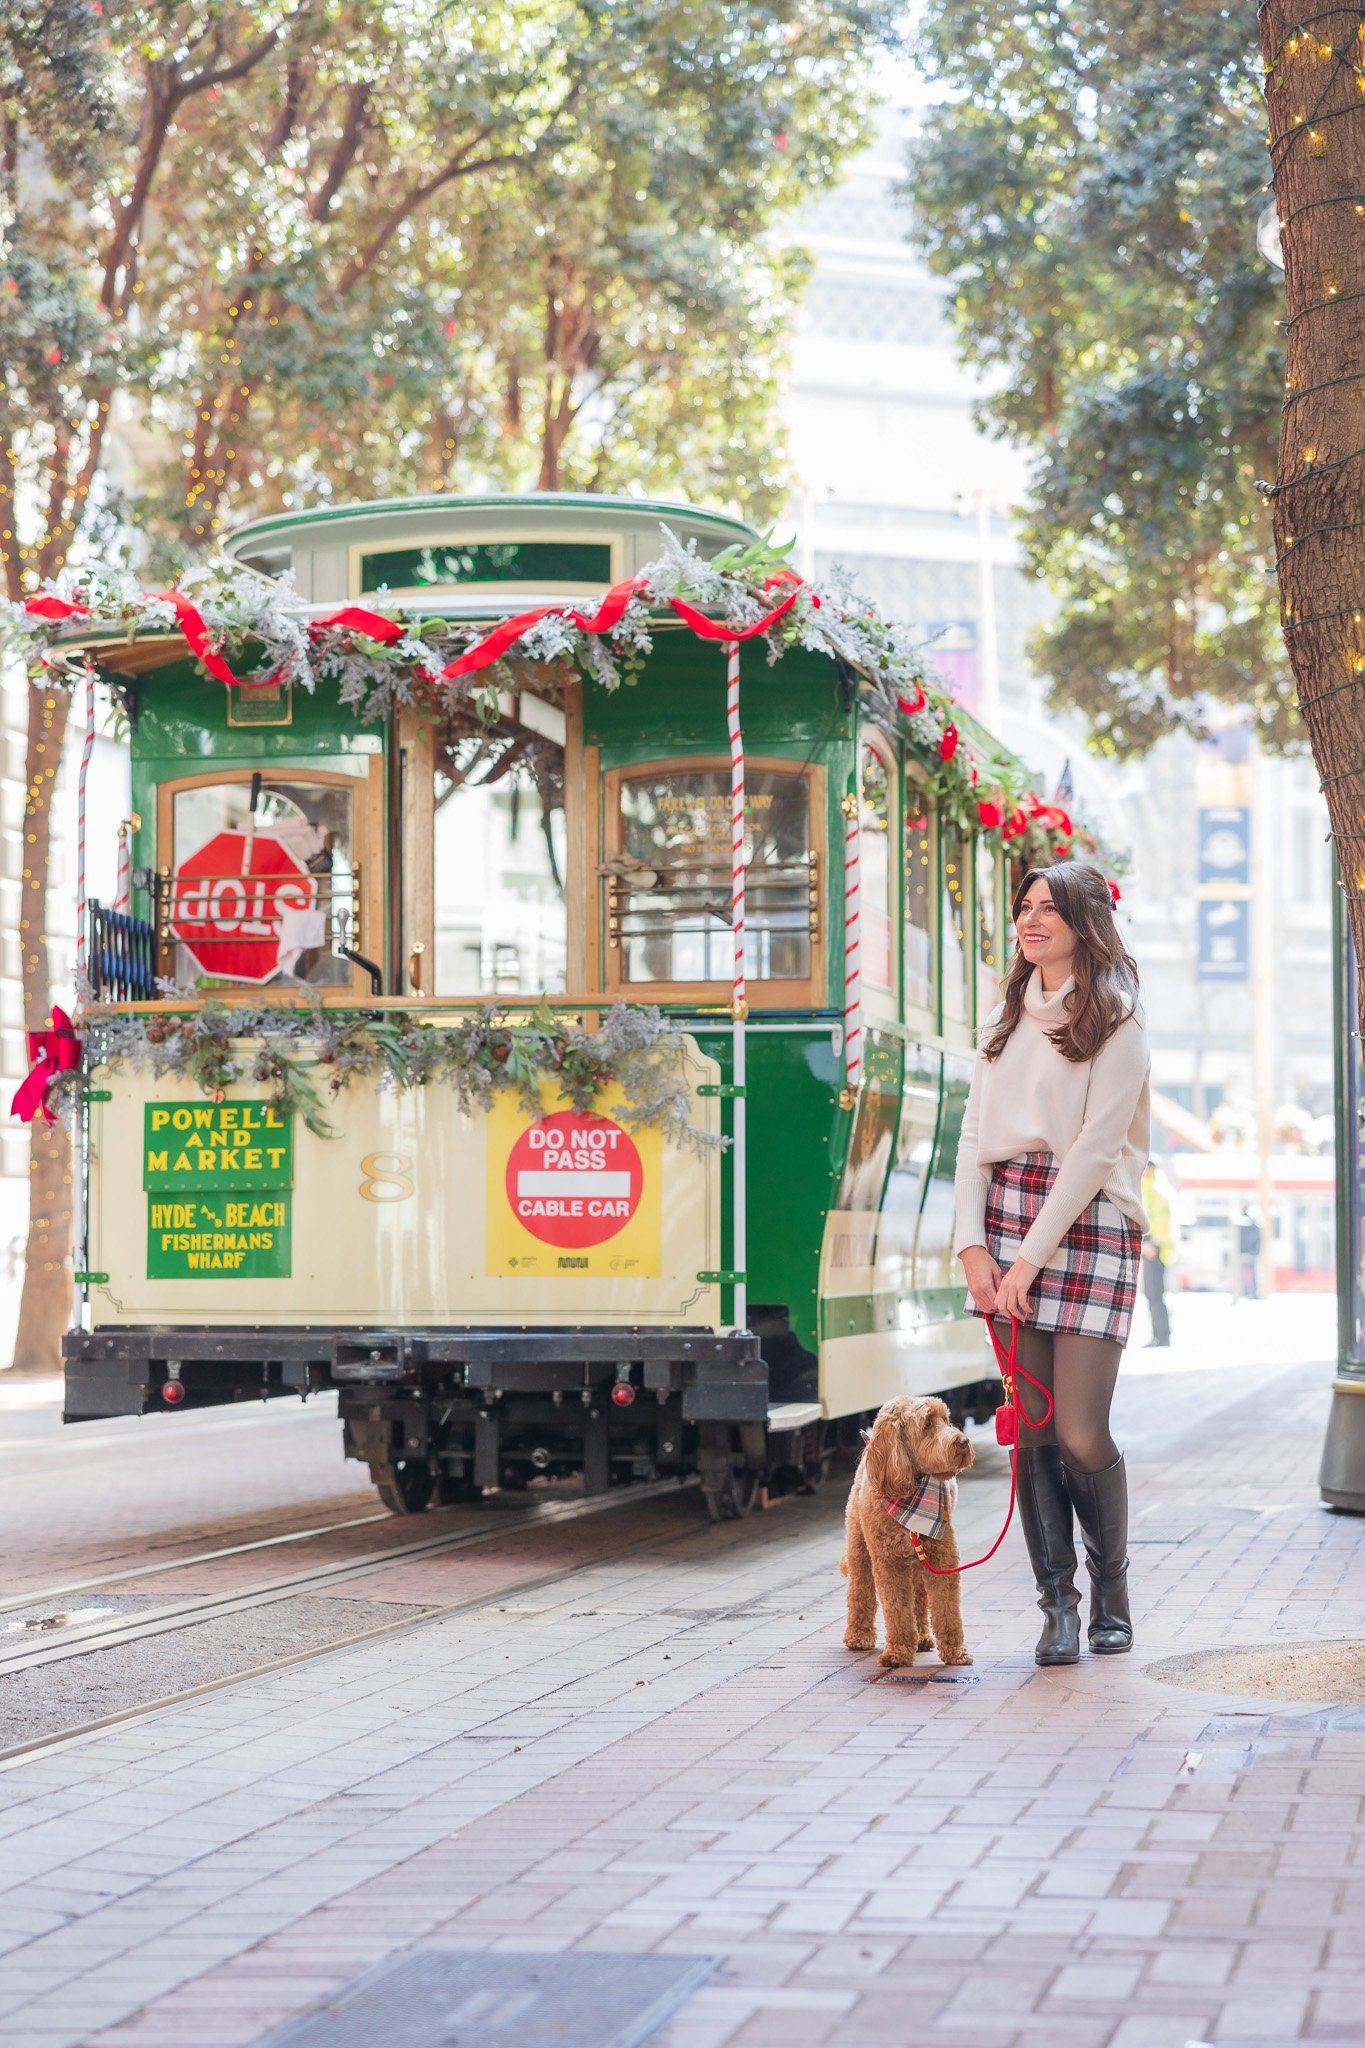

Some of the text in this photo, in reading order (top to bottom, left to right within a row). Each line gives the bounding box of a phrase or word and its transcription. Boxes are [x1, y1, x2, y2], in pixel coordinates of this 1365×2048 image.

[725, 795, 748, 810] OE
[178, 878, 306, 937] STOP
[151, 1107, 285, 1132] POWELL
[185, 1129, 251, 1148] AND
[528, 1129, 622, 1150] DO NOT
[147, 1148, 286, 1172] MARKET
[543, 1150, 606, 1170] PASS
[358, 1151, 415, 1203] 8
[151, 1202, 286, 1229] HYDE AND BEACH
[518, 1199, 630, 1217] CABLE CAR
[161, 1232, 273, 1252] FISHERMANS
[187, 1252, 246, 1269] WHARF
